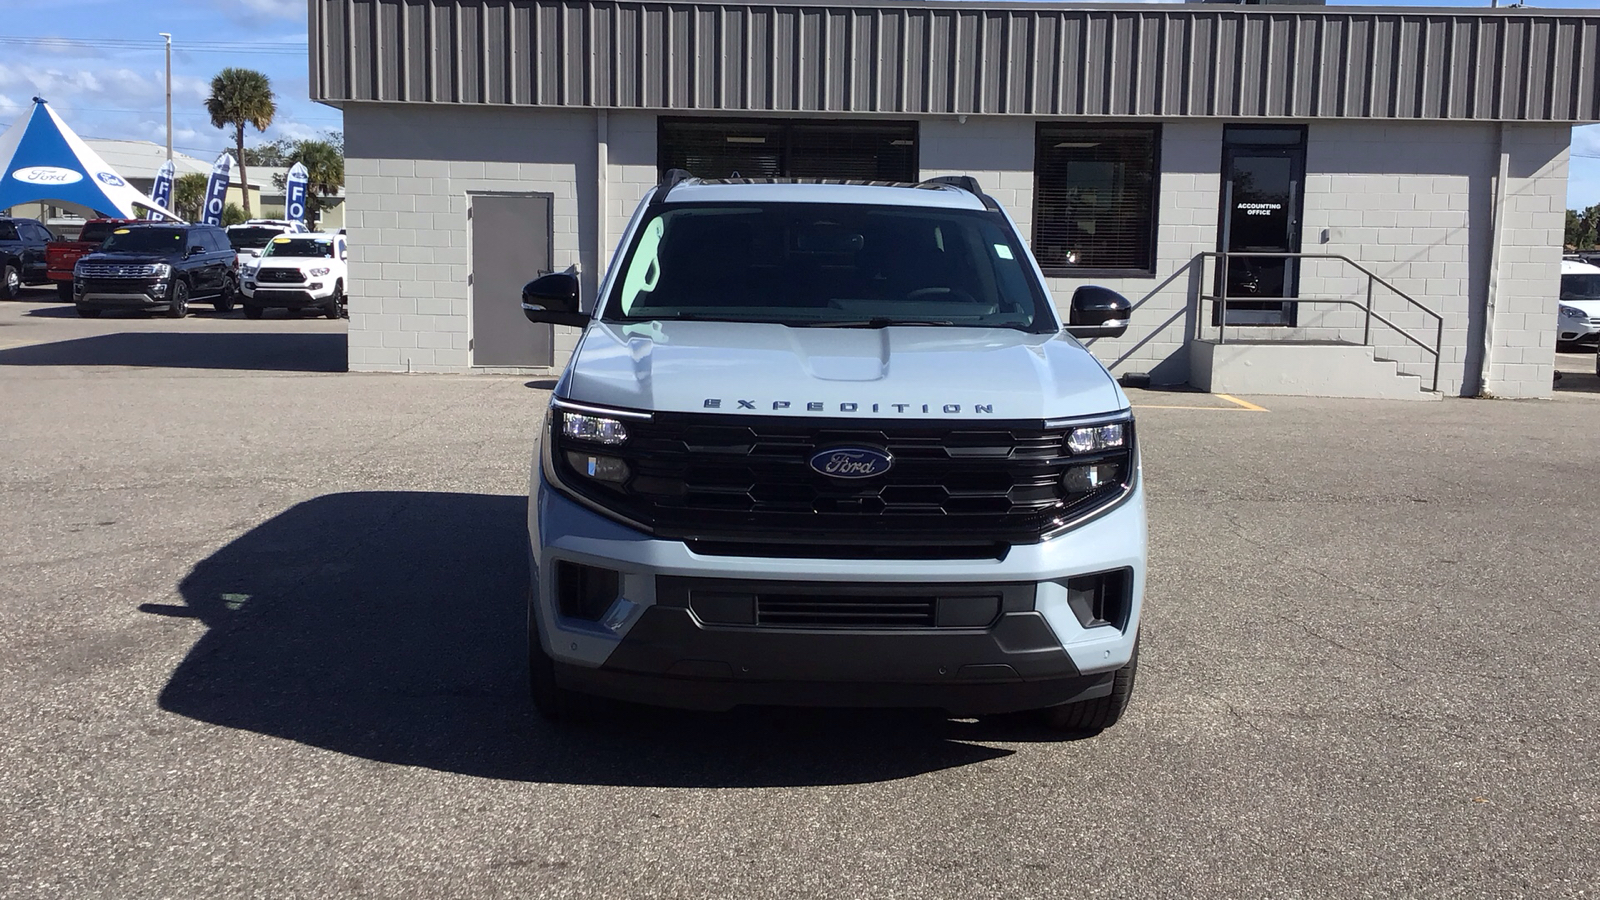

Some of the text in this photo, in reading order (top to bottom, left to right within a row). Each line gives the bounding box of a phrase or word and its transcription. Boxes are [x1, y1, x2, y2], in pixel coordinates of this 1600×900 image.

[27, 169, 67, 181] Ford
[703, 398, 993, 414] EXPEDITION
[825, 452, 876, 474] Ford
